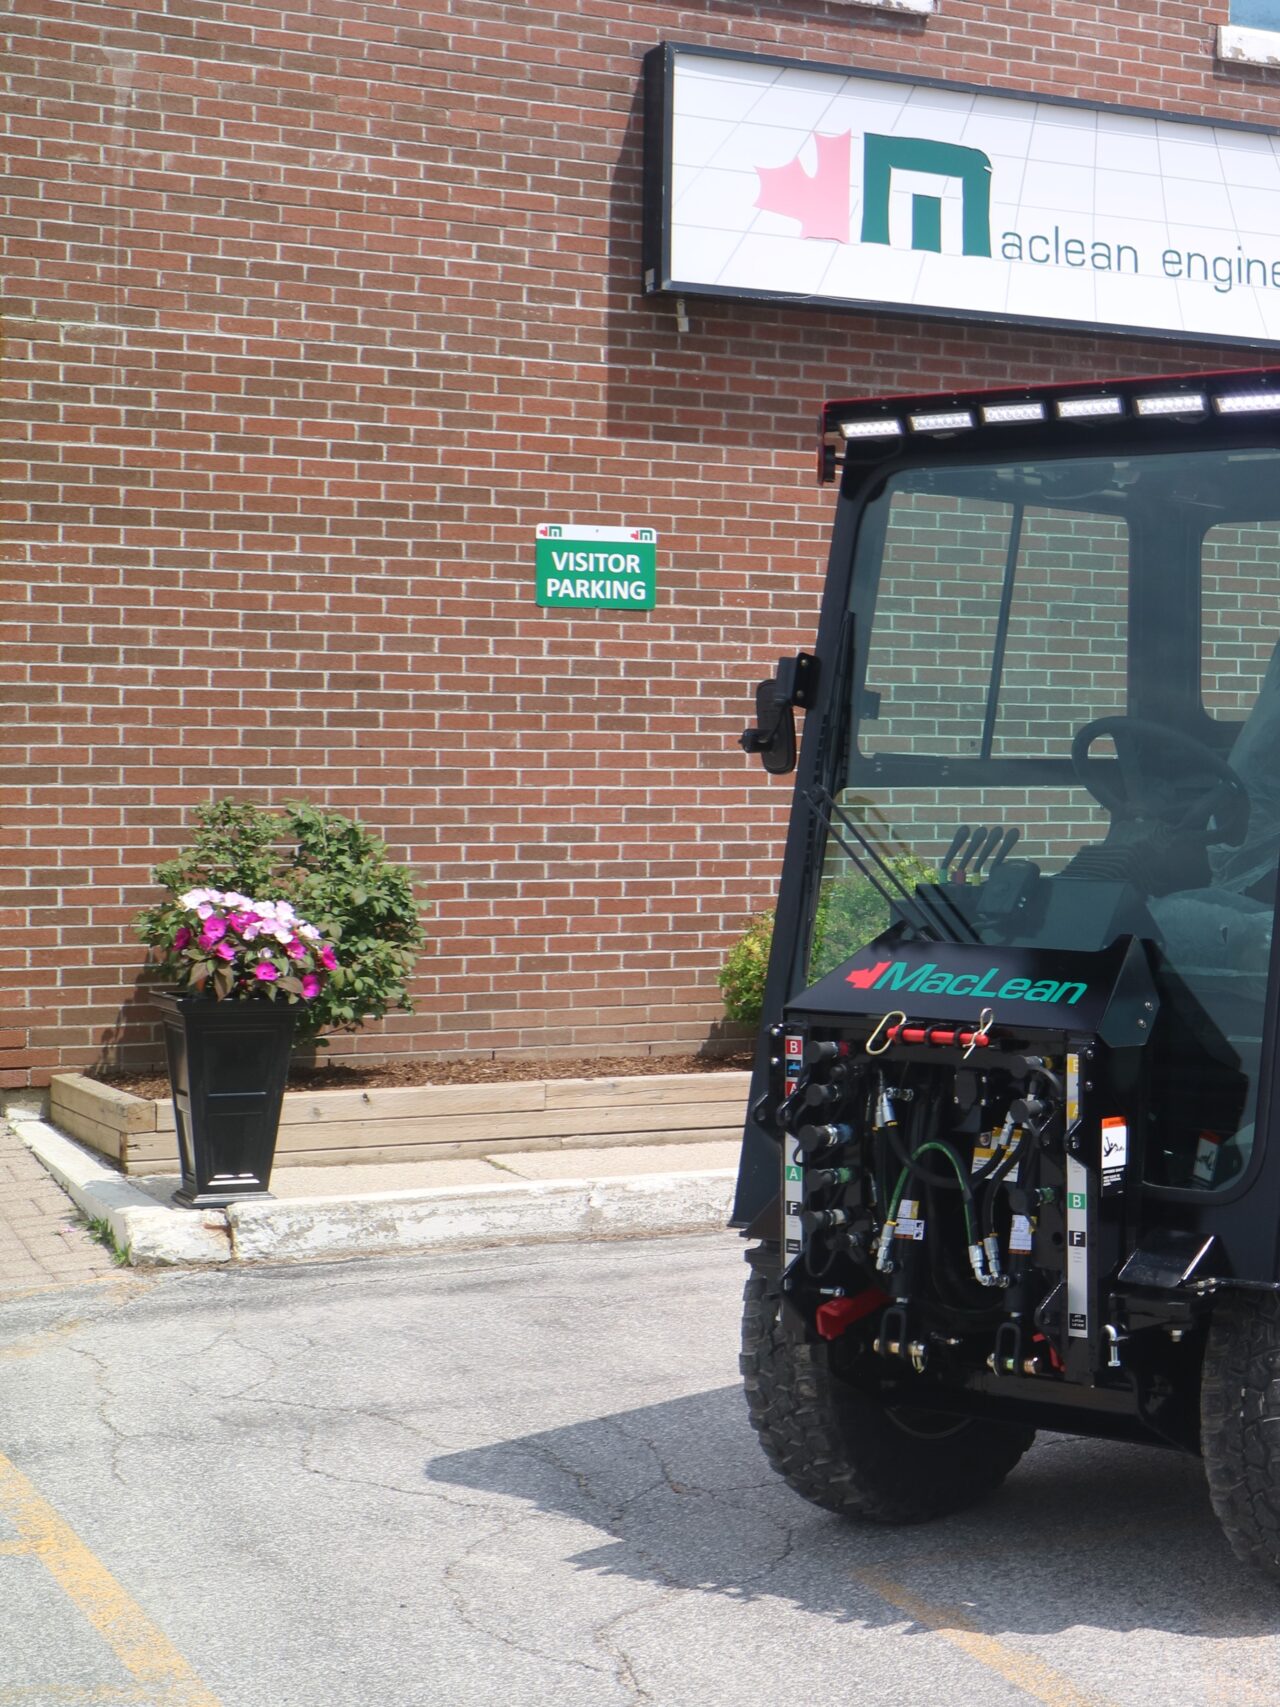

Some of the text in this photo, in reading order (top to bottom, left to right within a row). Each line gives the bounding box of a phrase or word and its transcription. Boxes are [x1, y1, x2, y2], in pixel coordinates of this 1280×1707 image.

[551, 552, 640, 573] VISITOR
[546, 578, 646, 600] PARKING
[875, 961, 1088, 1005] MacLean
[790, 1040, 798, 1053] B
[789, 1168, 798, 1180] A
[1072, 1194, 1081, 1208] B
[789, 1202, 798, 1215] F
[1073, 1232, 1081, 1245] F
